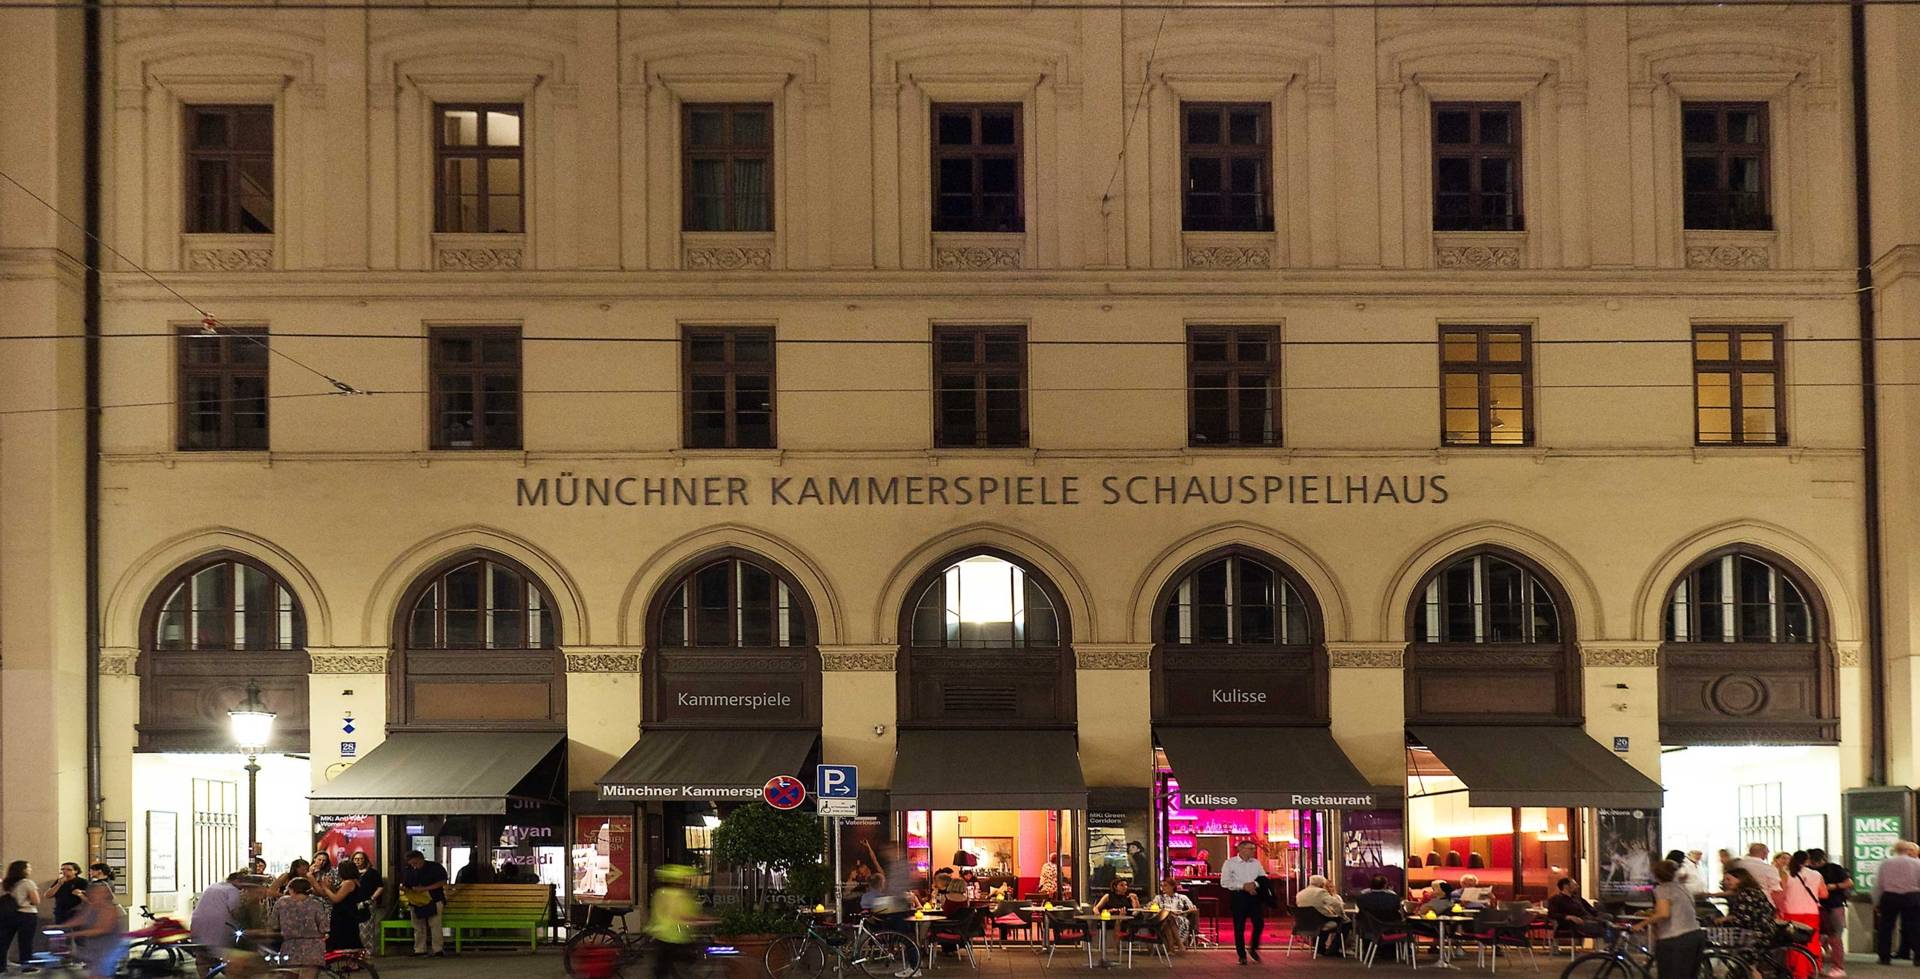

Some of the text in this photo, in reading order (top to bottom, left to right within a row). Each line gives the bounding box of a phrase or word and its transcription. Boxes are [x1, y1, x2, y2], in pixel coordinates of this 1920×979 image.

[516, 471, 1450, 507] MÜNCHNER KAMMERSPIELE SCHAUSPIELHAUS
[678, 692, 791, 709] Kammerspiele
[1212, 688, 1267, 703] Kulisse
[342, 743, 354, 751] 28
[824, 769, 846, 794] P
[603, 785, 763, 799] Münchner Kammersp
[1184, 793, 1372, 805] Kulisse Restaurant
[1855, 818, 1899, 832] MK:
